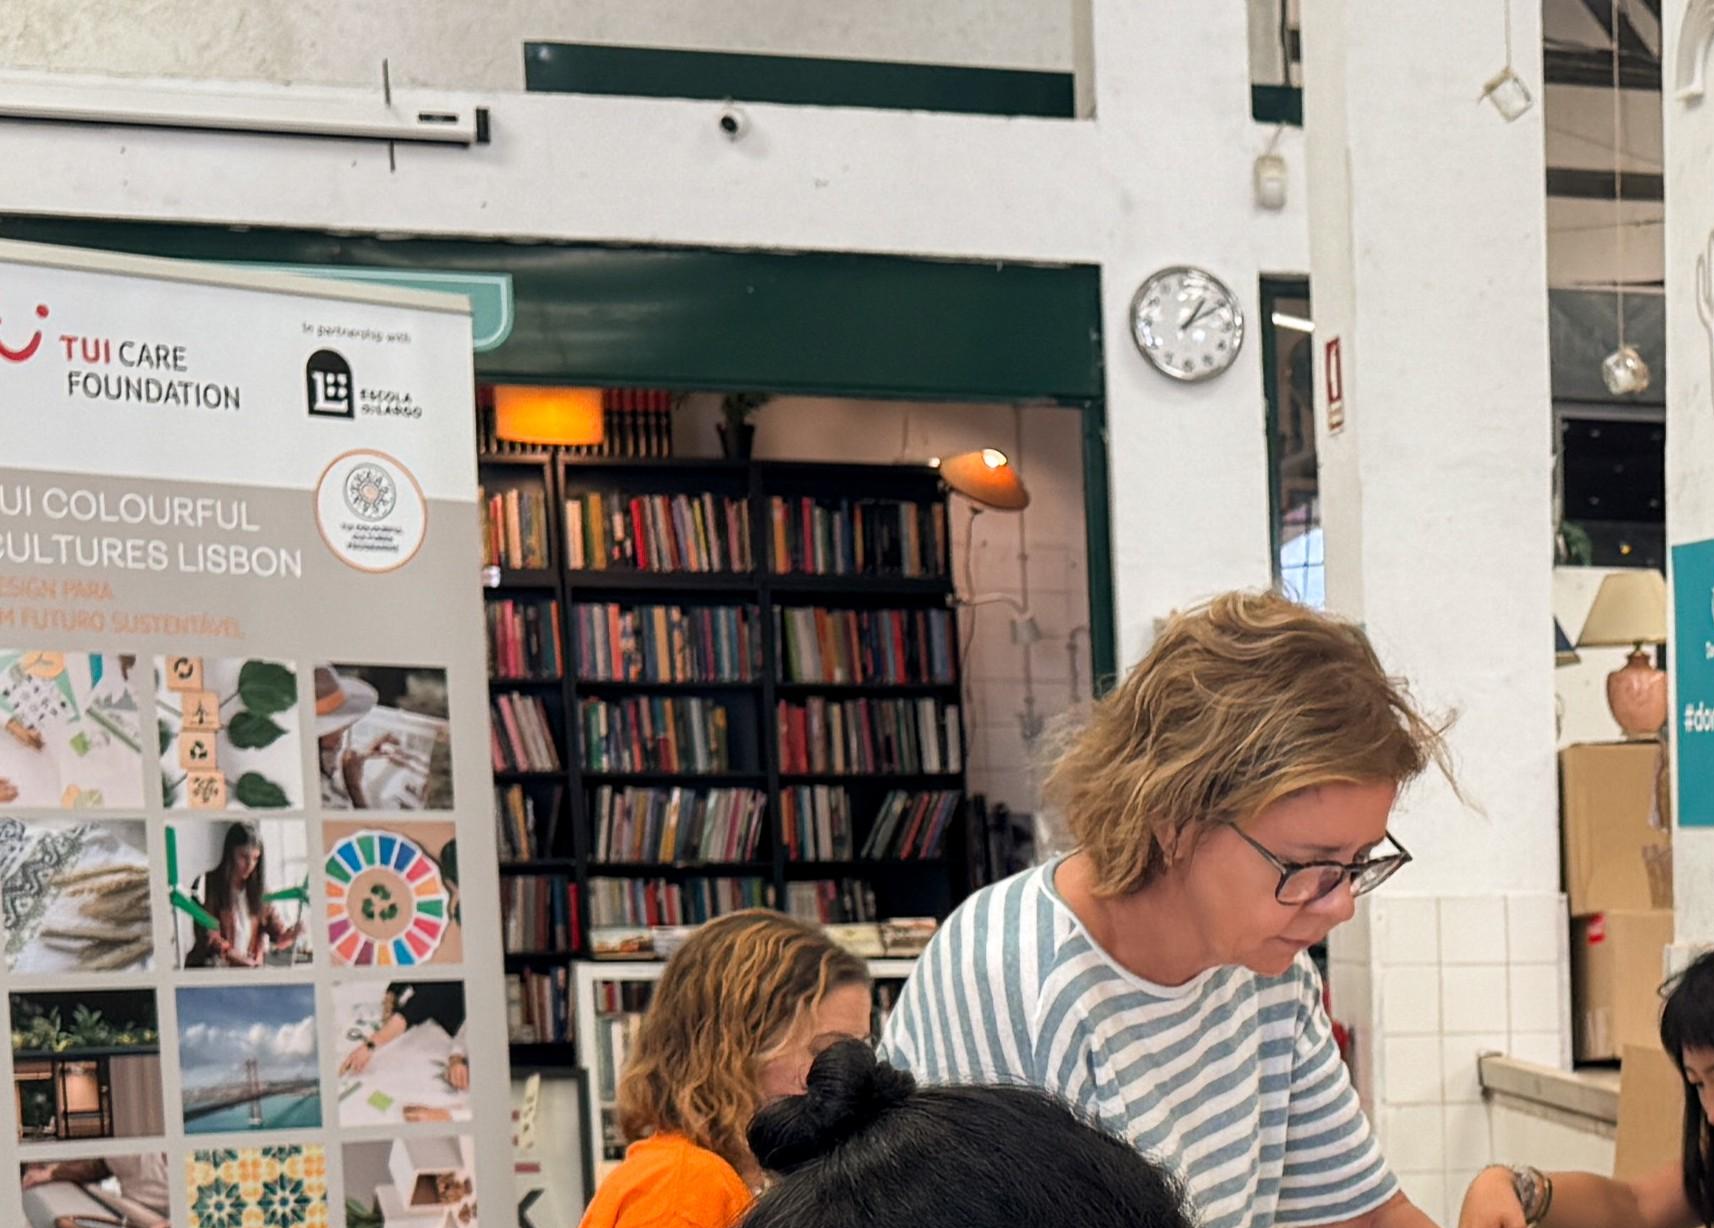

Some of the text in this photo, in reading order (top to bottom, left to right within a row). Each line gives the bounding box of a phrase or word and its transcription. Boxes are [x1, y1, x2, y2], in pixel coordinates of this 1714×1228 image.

[59, 334, 188, 372] TUI CARE
[68, 370, 241, 411] FOUNDATION
[42, 487, 261, 532] COLOURFUL
[178, 541, 303, 579] LISBON
[63, 580, 113, 601] PARA
[21, 608, 105, 632] FUTURO
